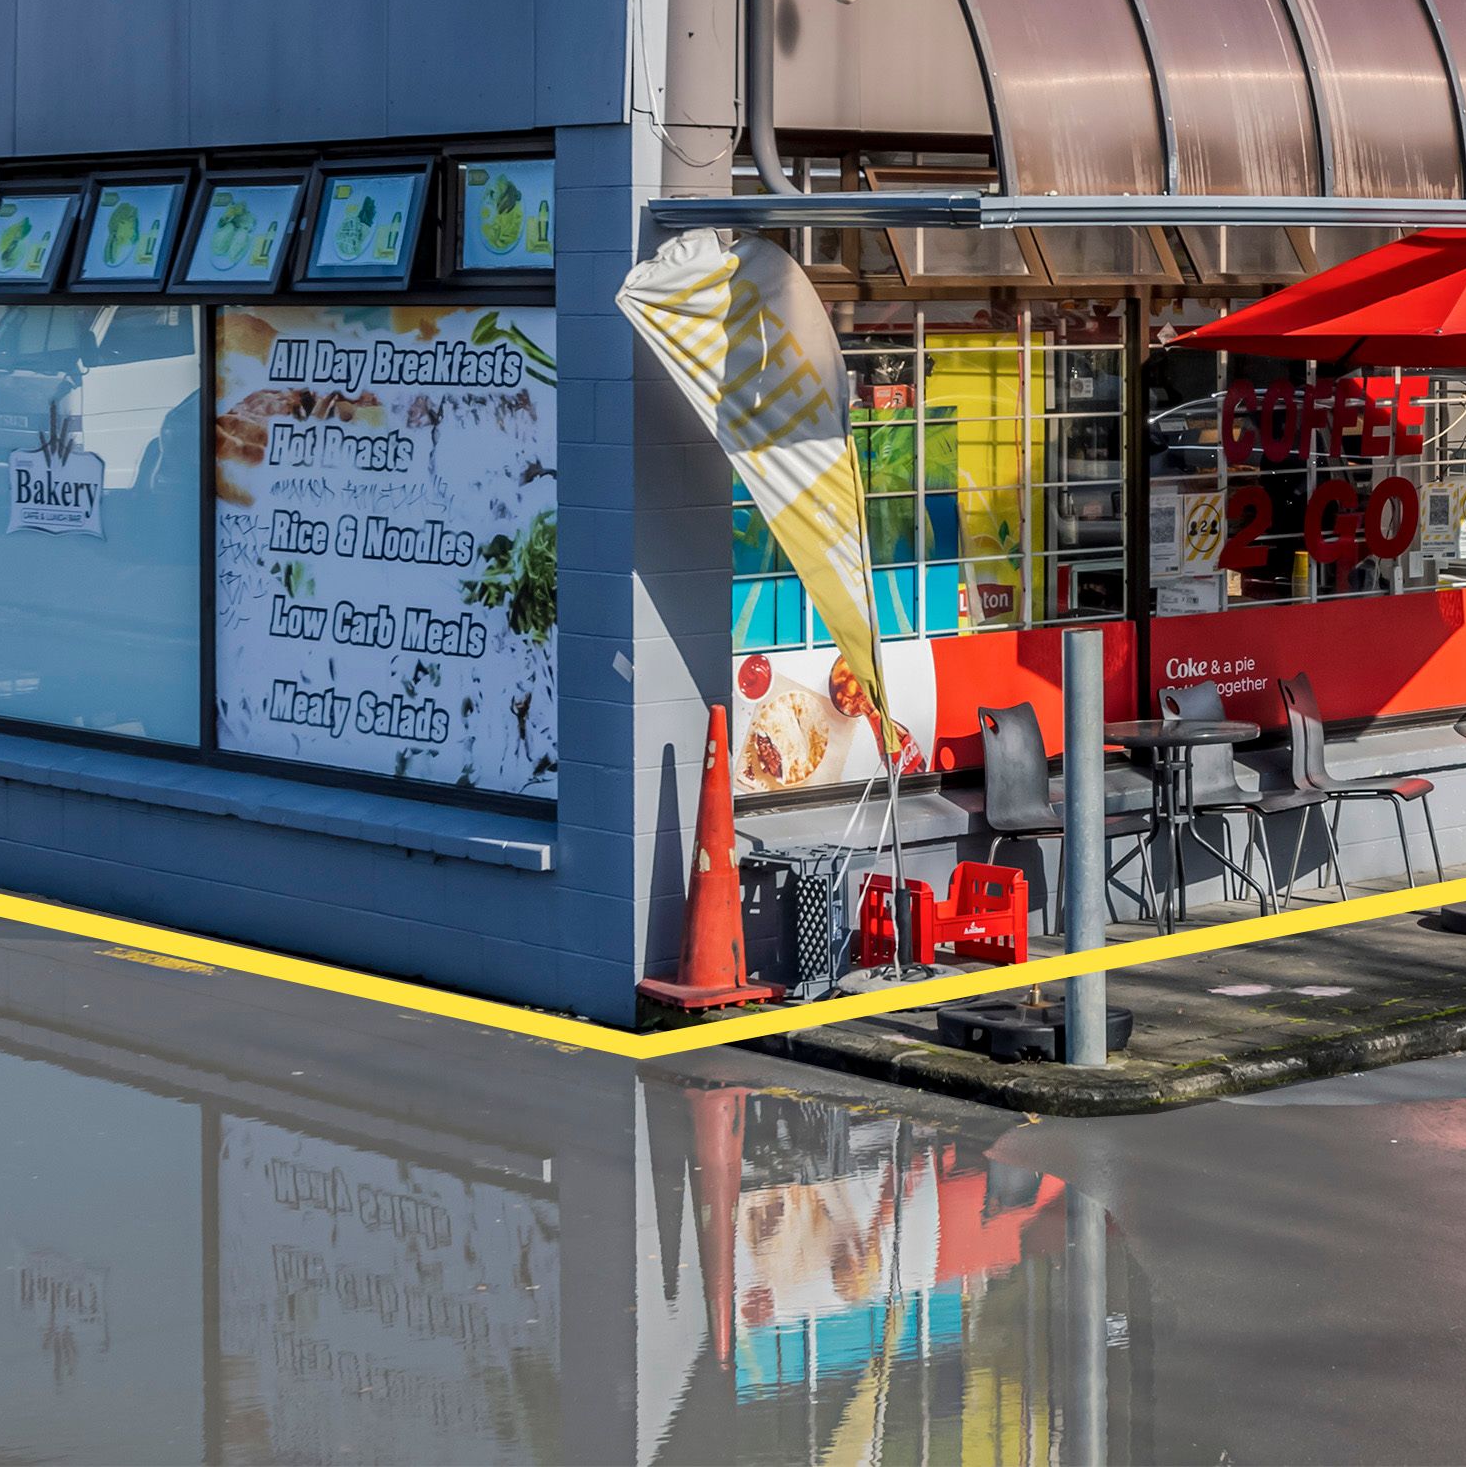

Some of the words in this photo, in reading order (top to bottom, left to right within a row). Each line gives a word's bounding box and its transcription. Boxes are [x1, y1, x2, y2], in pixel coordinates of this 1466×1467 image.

[269, 338, 309, 383] All
[313, 340, 368, 394] Day
[370, 340, 523, 388] Breakfasts
[1222, 375, 1430, 465] COFFEE
[269, 422, 316, 468] Hot
[321, 424, 414, 473] Roasts
[14, 467, 99, 519] Bakery
[269, 508, 329, 555] Rice
[335, 513, 359, 558] &
[362, 515, 475, 567] Noodles
[1200, 519, 1208, 533] 2
[1217, 484, 1273, 570] 2
[1303, 475, 1419, 565] GO
[269, 593, 328, 643] Low
[331, 599, 395, 647] Carb
[400, 606, 486, 660] Meals
[959, 591, 1009, 612] Lton
[1165, 657, 1208, 680] Coke
[1210, 659, 1221, 675] &
[1223, 660, 1232, 674] a
[1234, 656, 1256, 676] pie
[1215, 676, 1268, 698] ogether
[269, 679, 352, 738] Meaty
[355, 690, 450, 744] Salads
